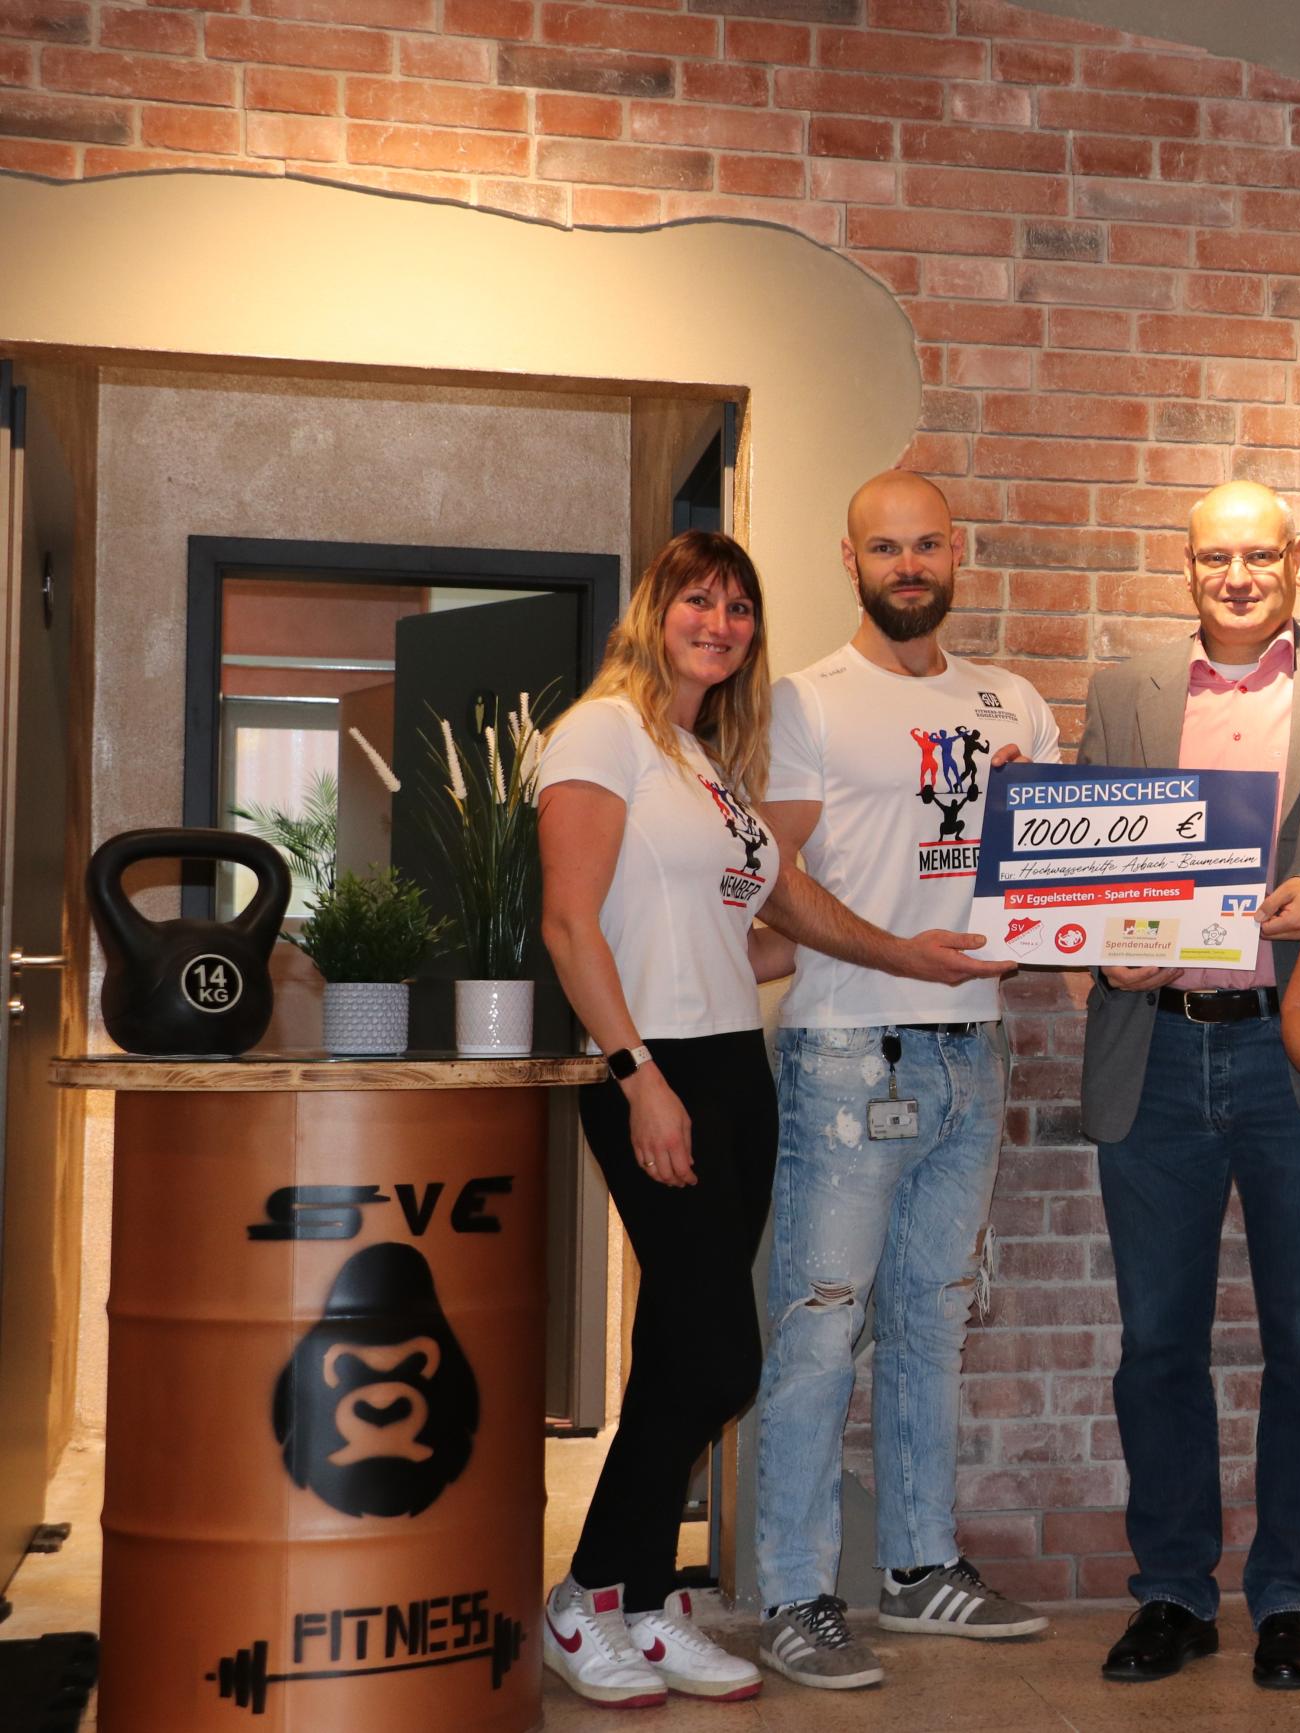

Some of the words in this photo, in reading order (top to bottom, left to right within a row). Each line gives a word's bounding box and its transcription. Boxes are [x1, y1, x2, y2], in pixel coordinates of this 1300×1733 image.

[1009, 780, 1195, 805] SPENDENSCHECK
[1176, 811, 1203, 839] €
[1019, 860, 1117, 878] Hochwasserhilfe
[719, 875, 761, 901] MEMBER
[1009, 894, 1024, 905] SV
[1027, 891, 1095, 906] Eggelstetten
[1104, 887, 1140, 900] Sparte
[1143, 887, 1180, 897] Fitness
[1011, 924, 1024, 932] SV
[1105, 940, 1172, 950] Spendenaufruf
[193, 964, 228, 988] 14
[200, 987, 229, 1003] KG
[247, 1175, 515, 1240] SVE
[293, 1590, 489, 1664] FITNESS
